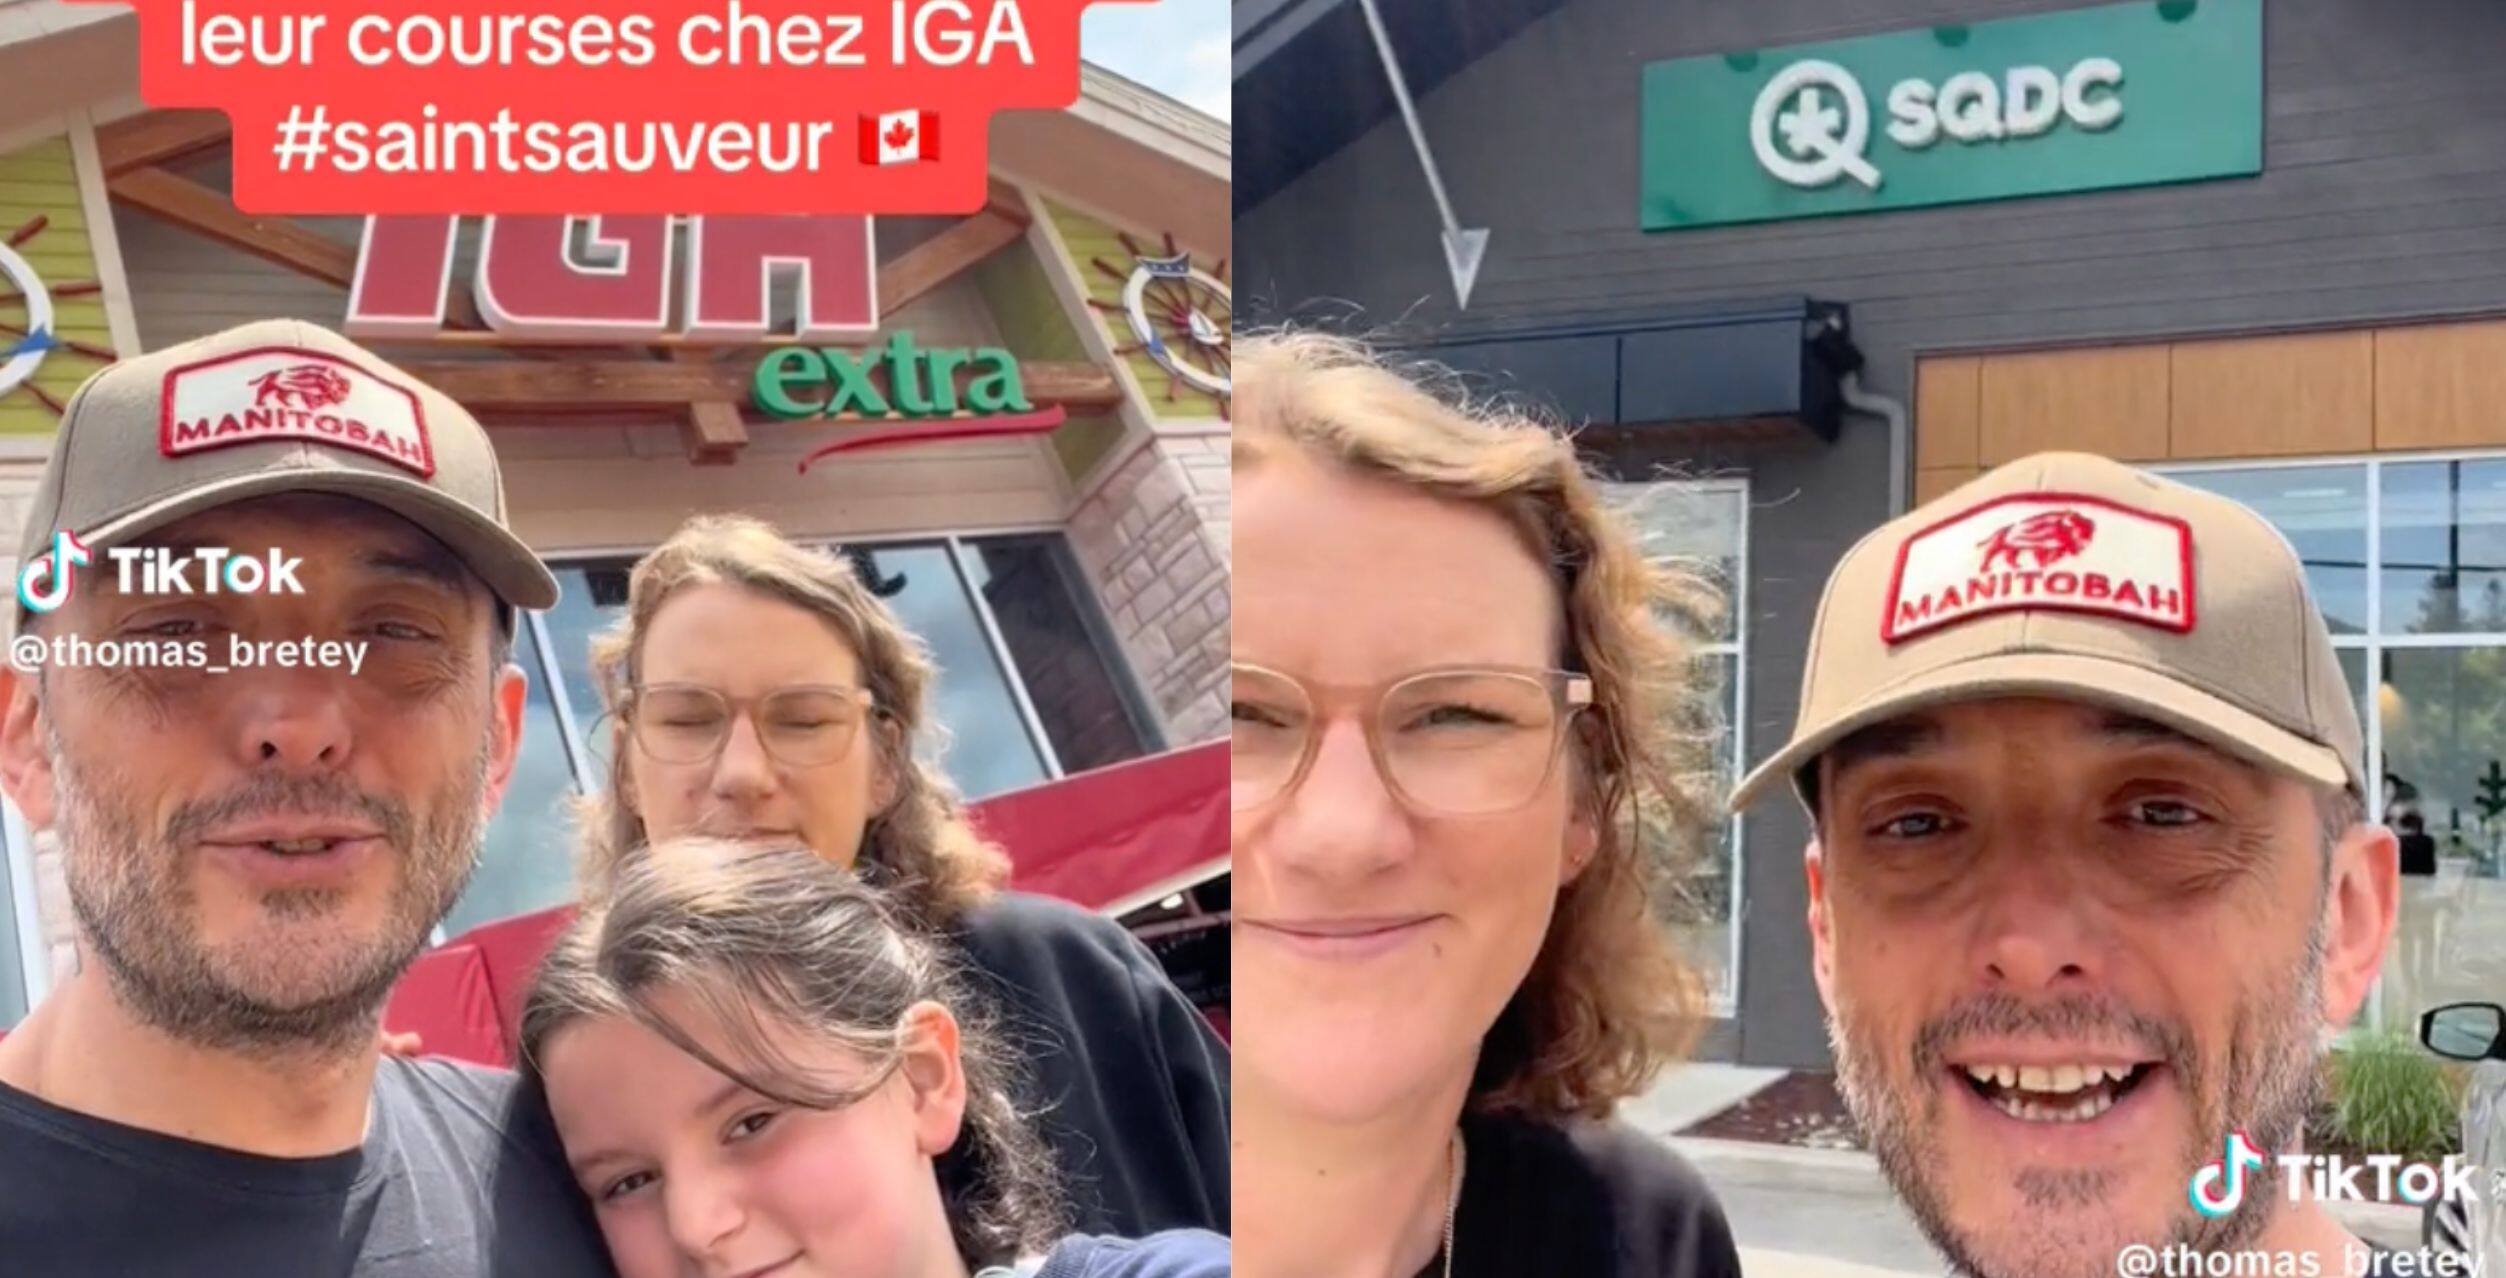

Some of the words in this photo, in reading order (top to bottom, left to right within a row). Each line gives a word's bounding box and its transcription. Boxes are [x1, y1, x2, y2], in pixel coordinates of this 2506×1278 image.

[1887, 57, 2125, 148] SQDC
[754, 330, 1034, 419] extra
[175, 409, 421, 463] MANITOBAH
[1899, 571, 2180, 628] MANITOBAH
